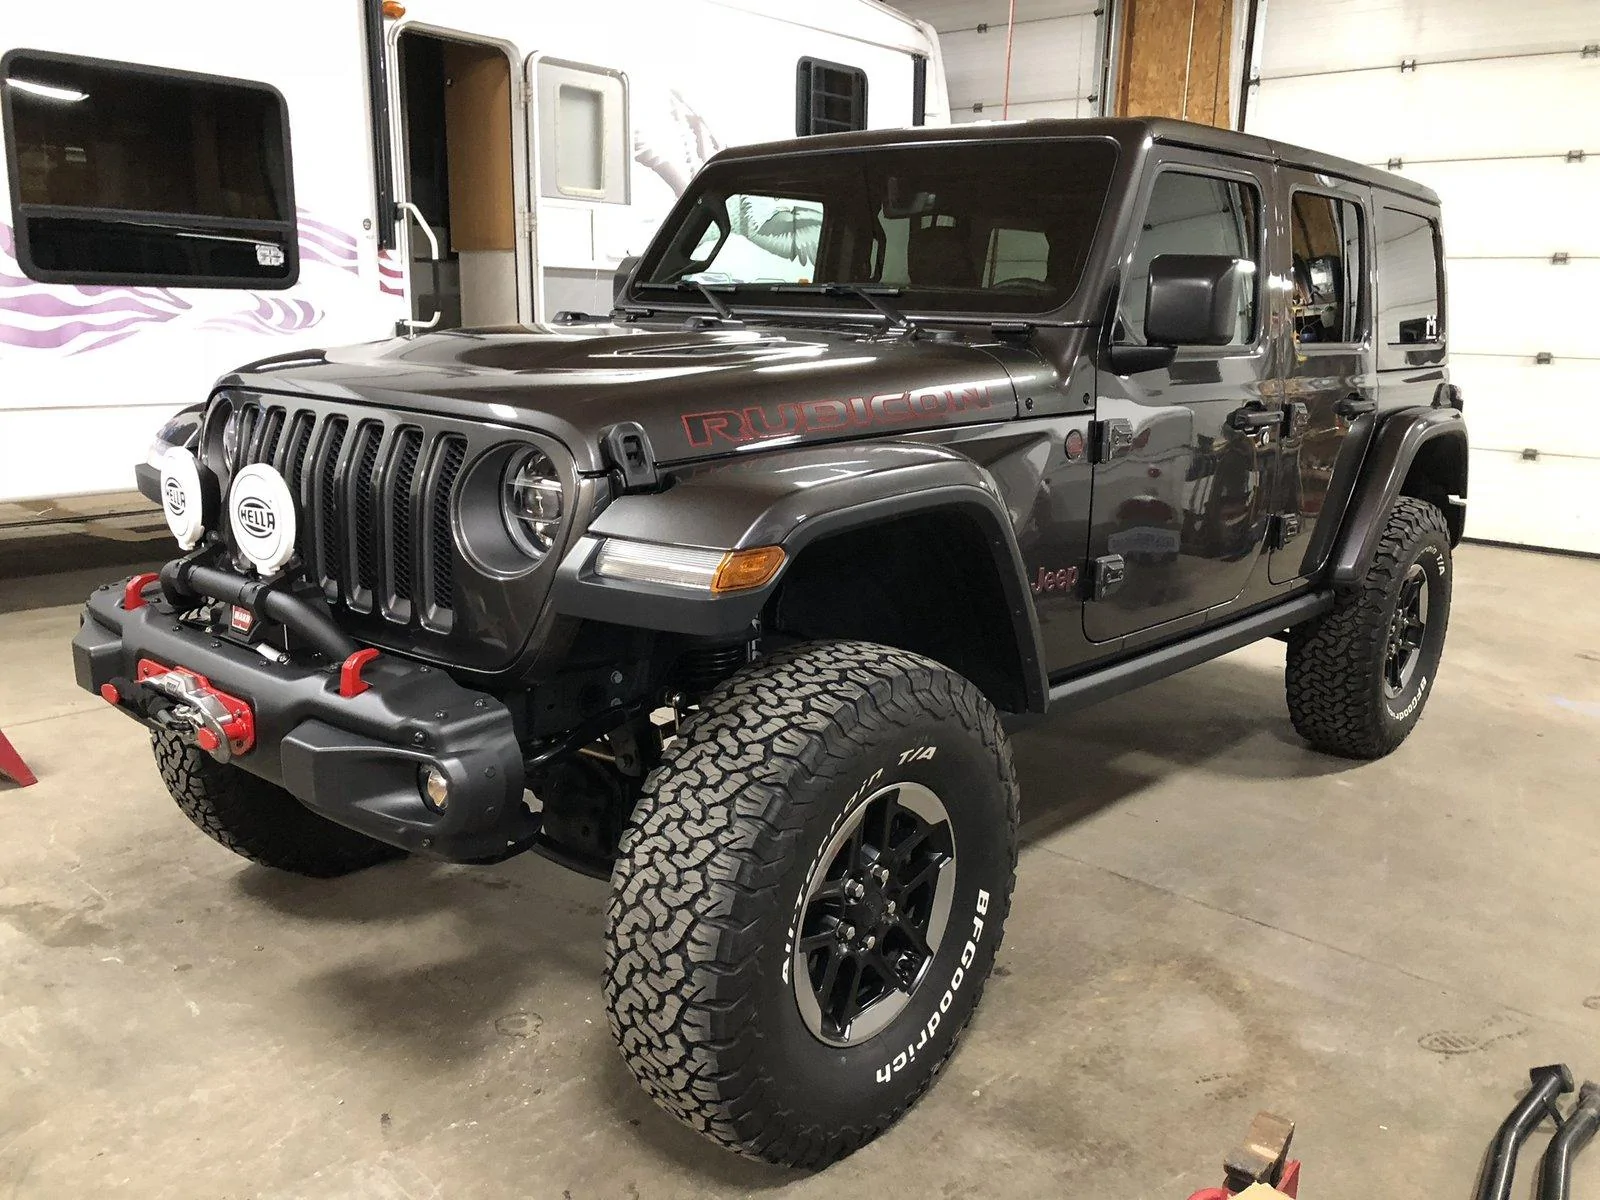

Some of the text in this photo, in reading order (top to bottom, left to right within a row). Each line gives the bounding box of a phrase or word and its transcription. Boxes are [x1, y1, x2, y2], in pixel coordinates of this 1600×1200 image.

[680, 386, 992, 448] RUBICON
[240, 510, 276, 530] HELLA
[1436, 553, 1446, 577] T/A
[1030, 566, 1077, 594] Jeep
[897, 746, 937, 766] T/A
[876, 888, 990, 1084] BFGoodrich
